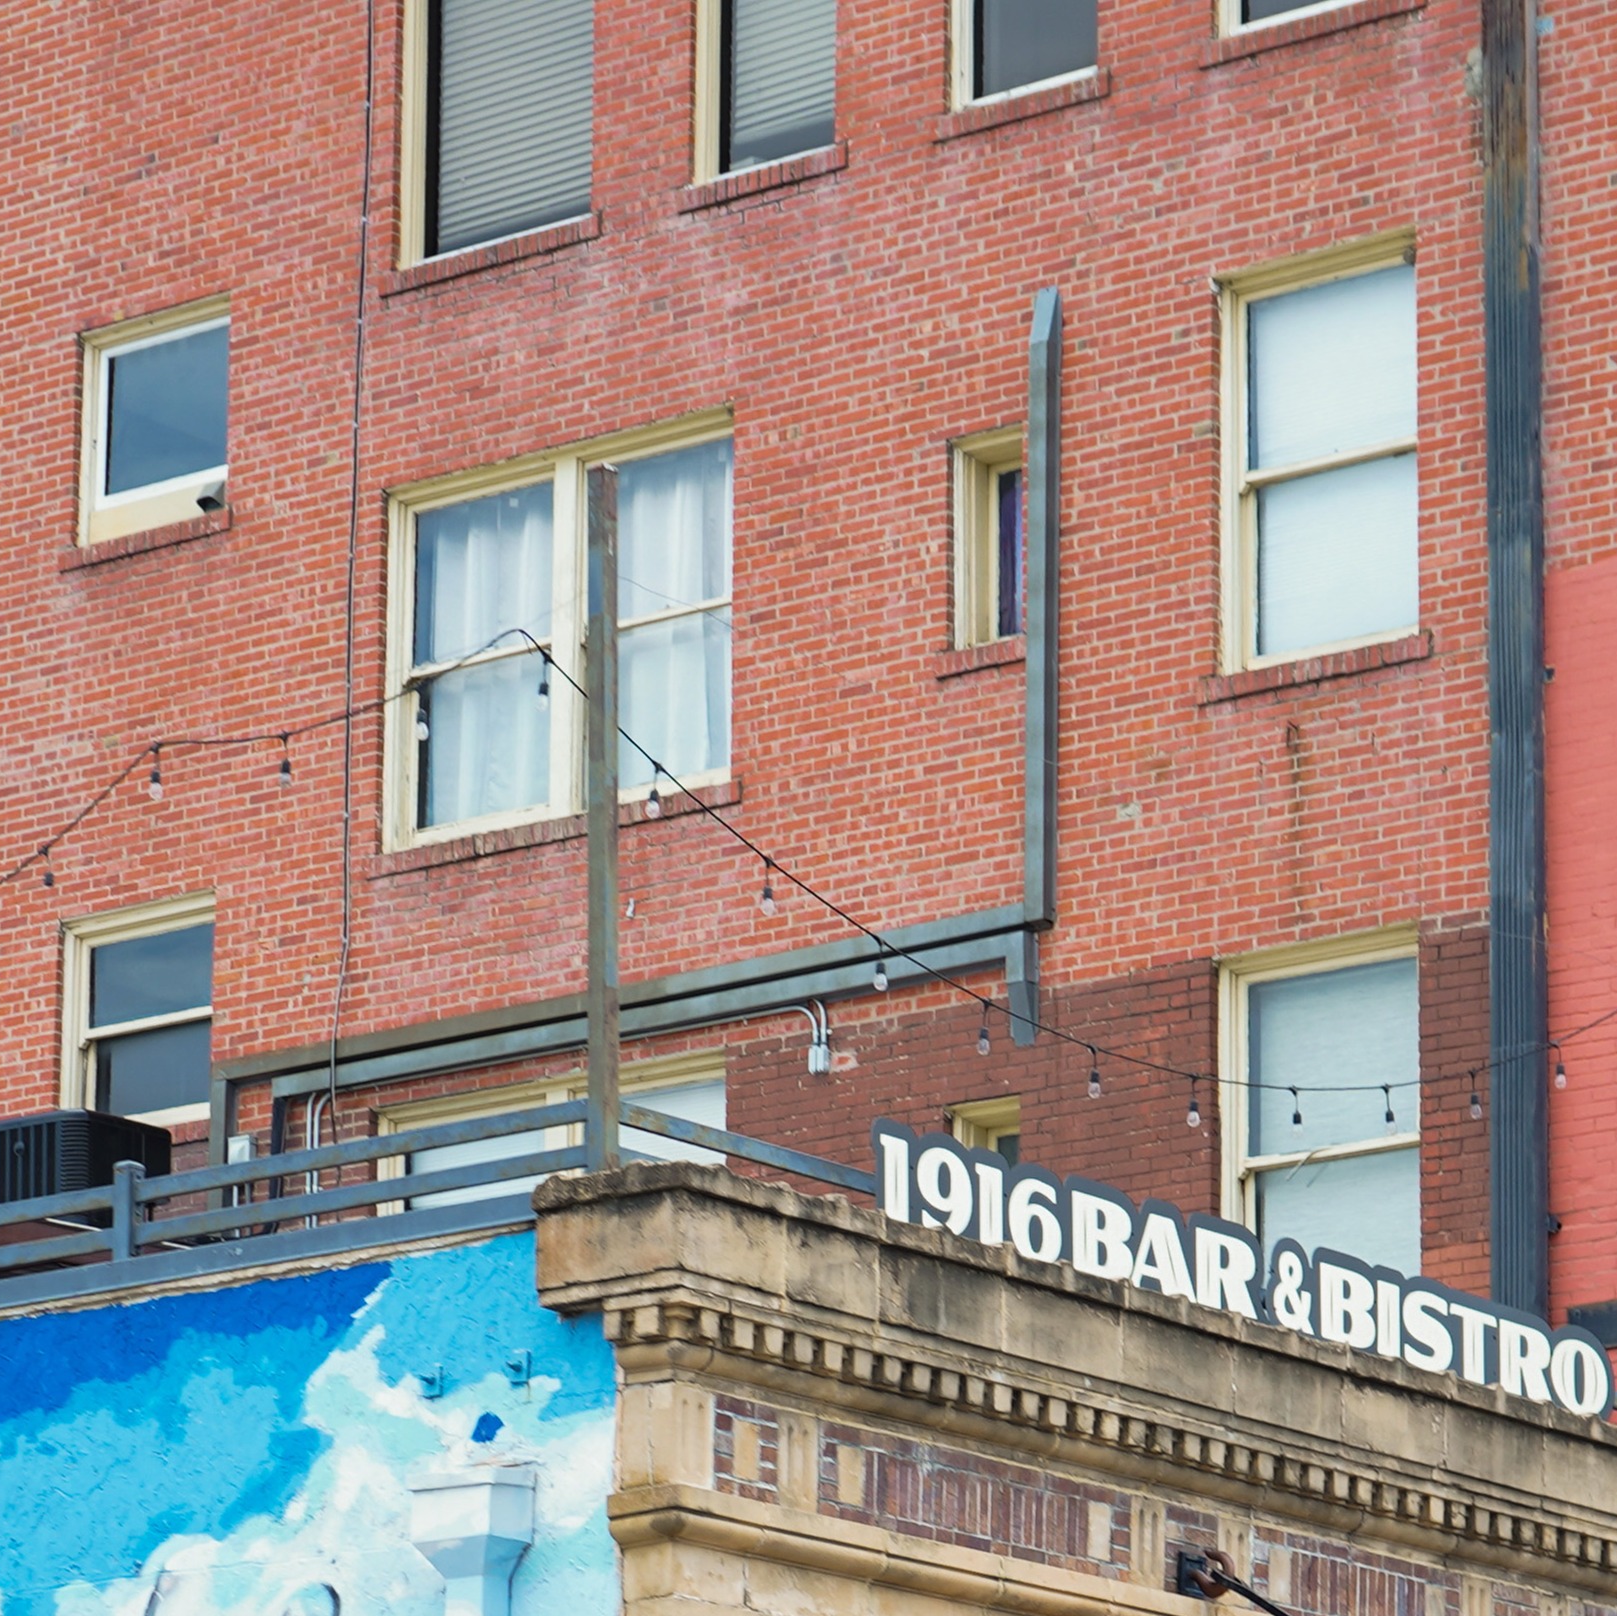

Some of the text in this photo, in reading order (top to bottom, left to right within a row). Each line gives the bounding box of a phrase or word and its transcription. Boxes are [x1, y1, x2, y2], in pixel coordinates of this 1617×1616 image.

[880, 1134, 1609, 1416] 1916 BAR & BISTRO
